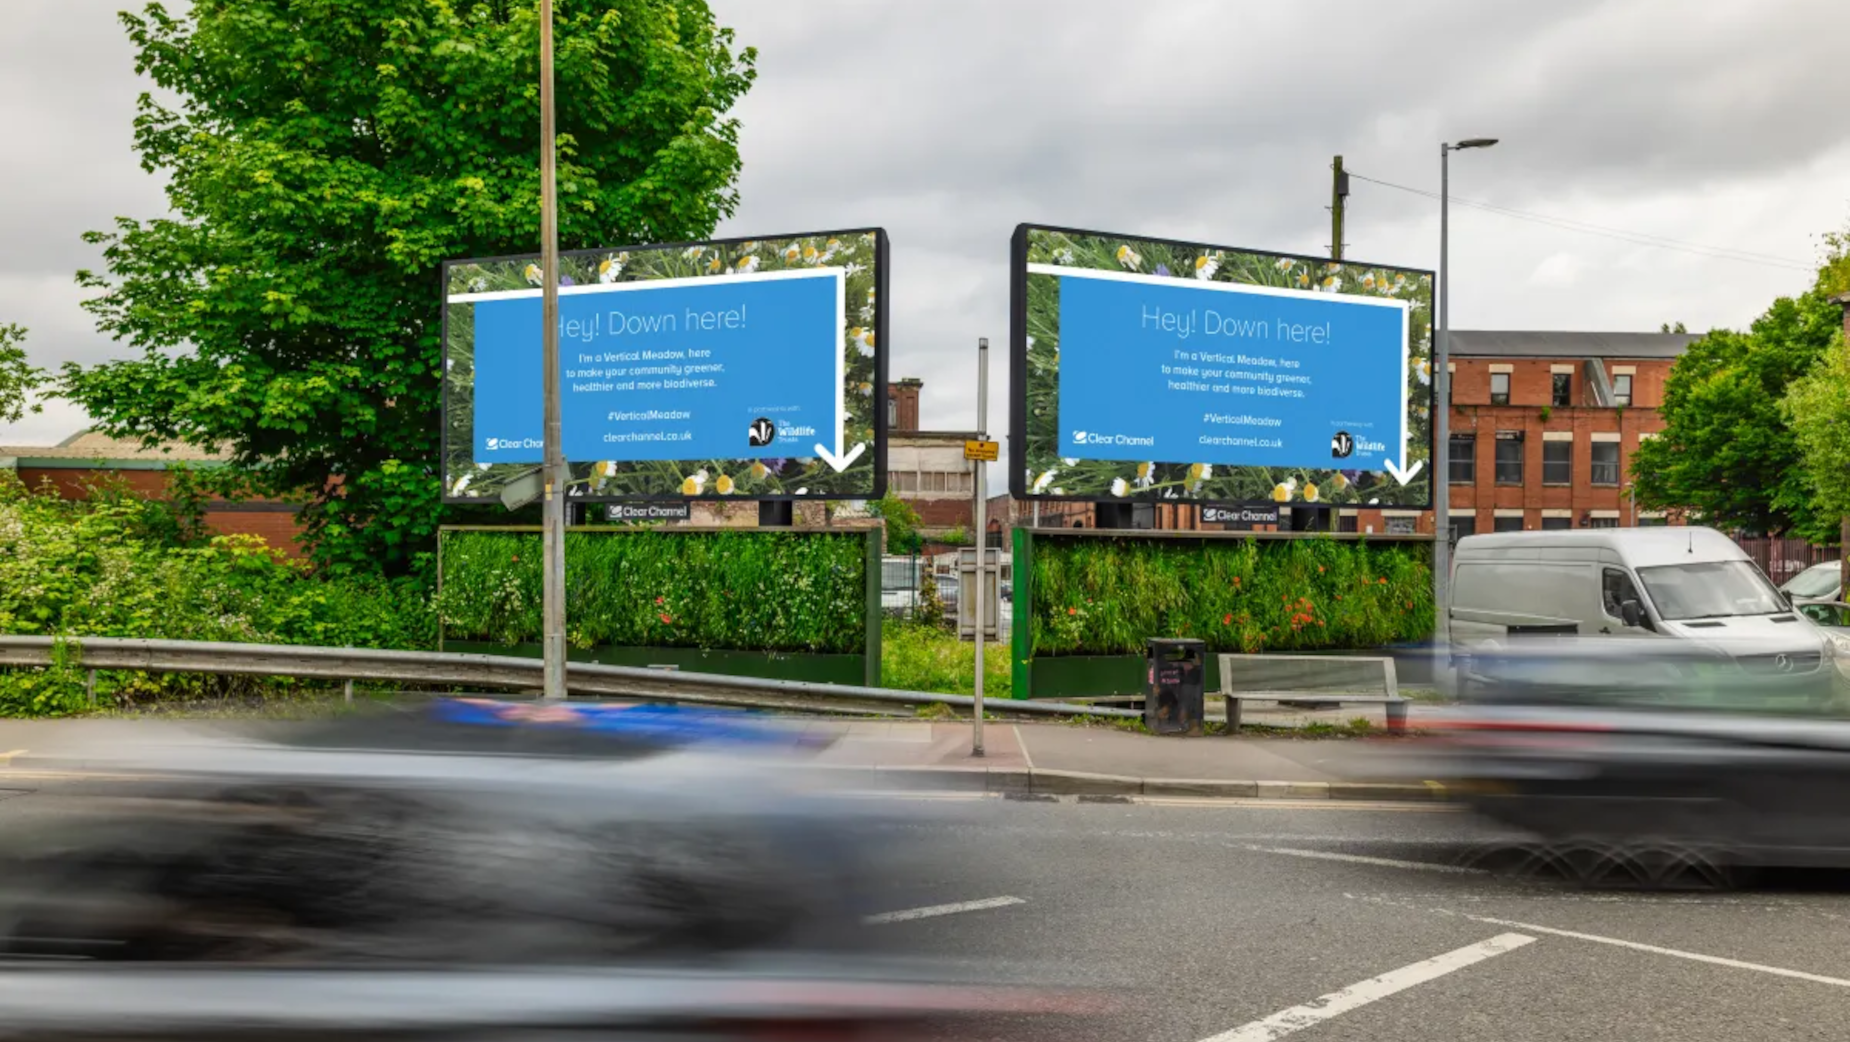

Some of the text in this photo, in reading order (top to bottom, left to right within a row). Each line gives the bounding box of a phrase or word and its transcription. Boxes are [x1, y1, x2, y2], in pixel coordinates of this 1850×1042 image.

[609, 311, 676, 335] Down
[686, 304, 745, 330] here!
[1142, 305, 1330, 344] Hey! Down here!
[579, 354, 593, 363] I'm
[604, 351, 640, 362] Vertical
[688, 348, 711, 358] here
[1174, 350, 1189, 360] I'm
[1199, 352, 1235, 363] Vertical
[1279, 358, 1300, 368] here
[566, 370, 576, 378] to
[577, 368, 603, 377] make
[605, 368, 627, 379] your
[629, 364, 682, 376] community
[1162, 364, 1171, 374] to
[1173, 366, 1199, 376] make
[1201, 369, 1223, 379] your
[1224, 370, 1274, 383] community
[573, 375, 717, 392] healthier and more biodiverse.
[1168, 378, 1304, 397] healthier and more biodiverse.
[608, 410, 690, 420] #VerticalMeadow
[1203, 413, 1281, 426] #VerticalMeadow
[603, 431, 691, 442] clearchannel.co.uk
[777, 426, 815, 436] Wildlife
[499, 438, 522, 448] Clear
[1087, 433, 1154, 446] Clear Channel
[1199, 435, 1282, 447] clearchannel.co.uk
[623, 505, 687, 517] Clear Channel
[1217, 510, 1277, 522] Clear Channel
